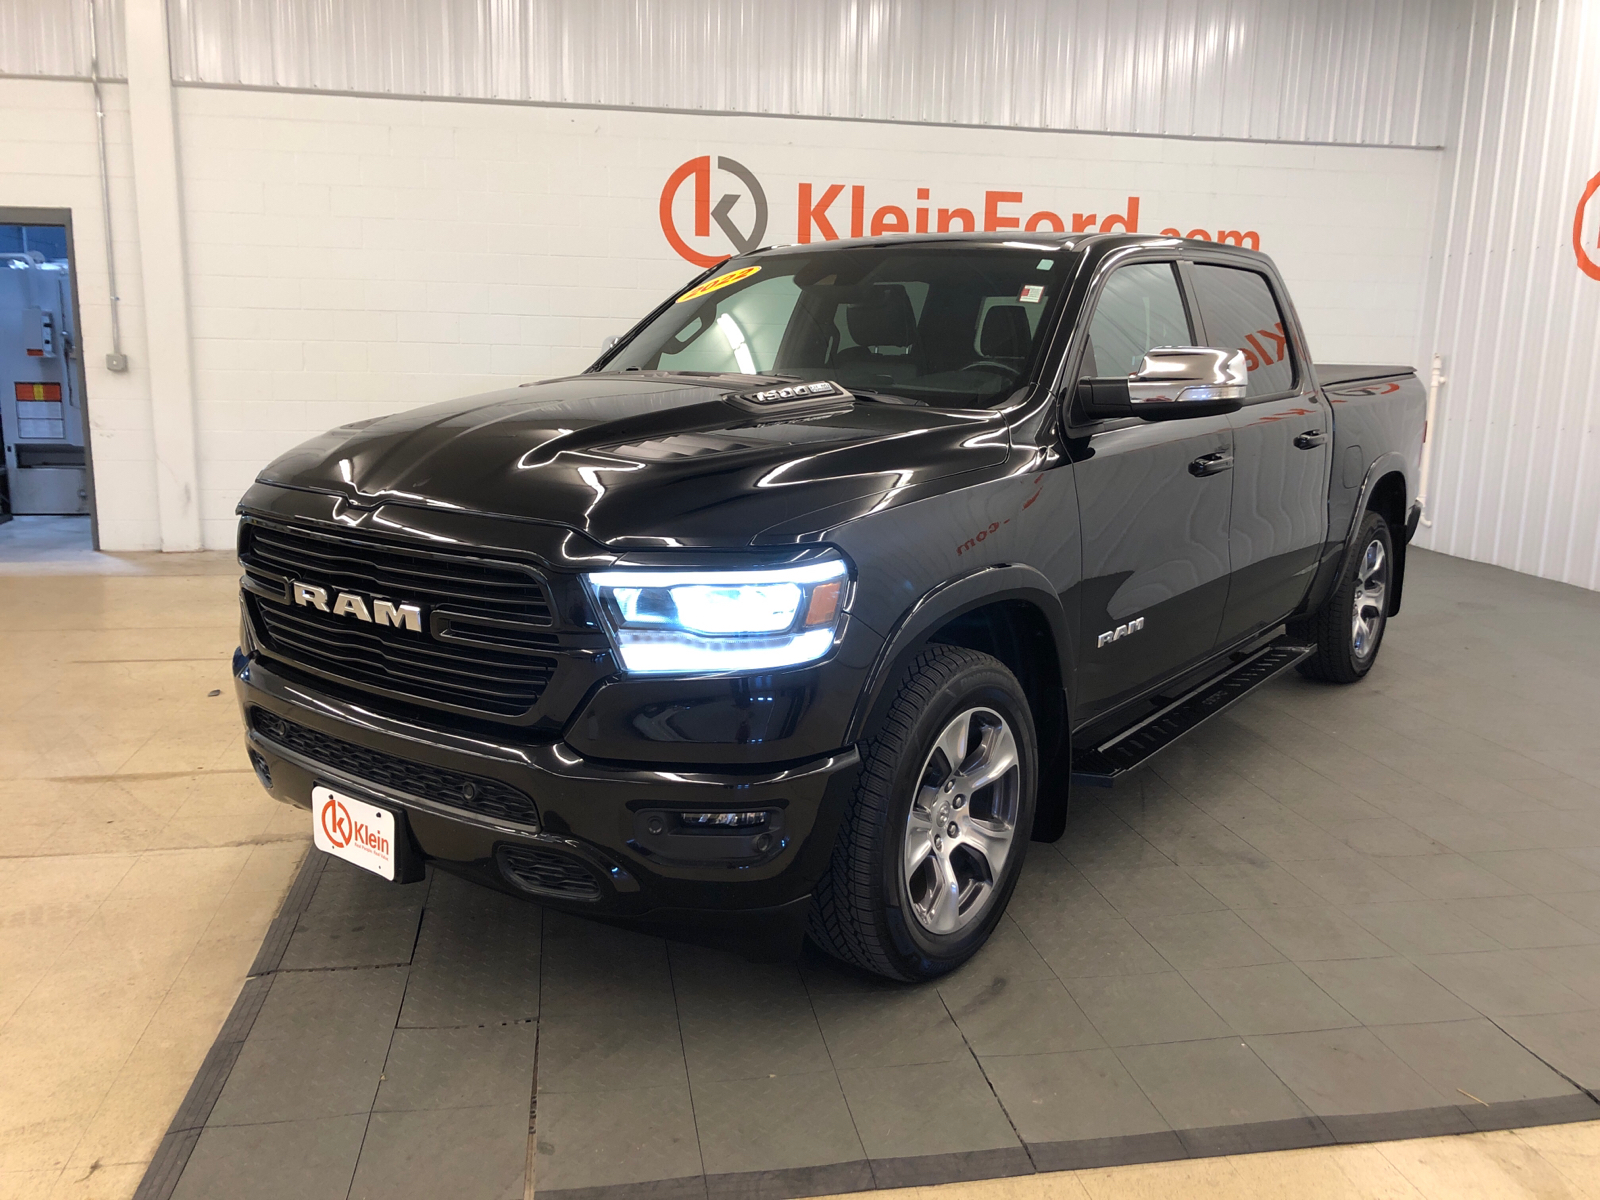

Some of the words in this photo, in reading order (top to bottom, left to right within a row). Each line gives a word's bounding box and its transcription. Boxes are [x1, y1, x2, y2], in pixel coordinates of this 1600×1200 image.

[797, 183, 1260, 251] KleinFordm
[681, 267, 755, 300] 2022
[753, 385, 810, 402] 1500
[293, 581, 422, 632] RAM
[1097, 616, 1145, 649] RAM
[354, 820, 389, 856] Klein
